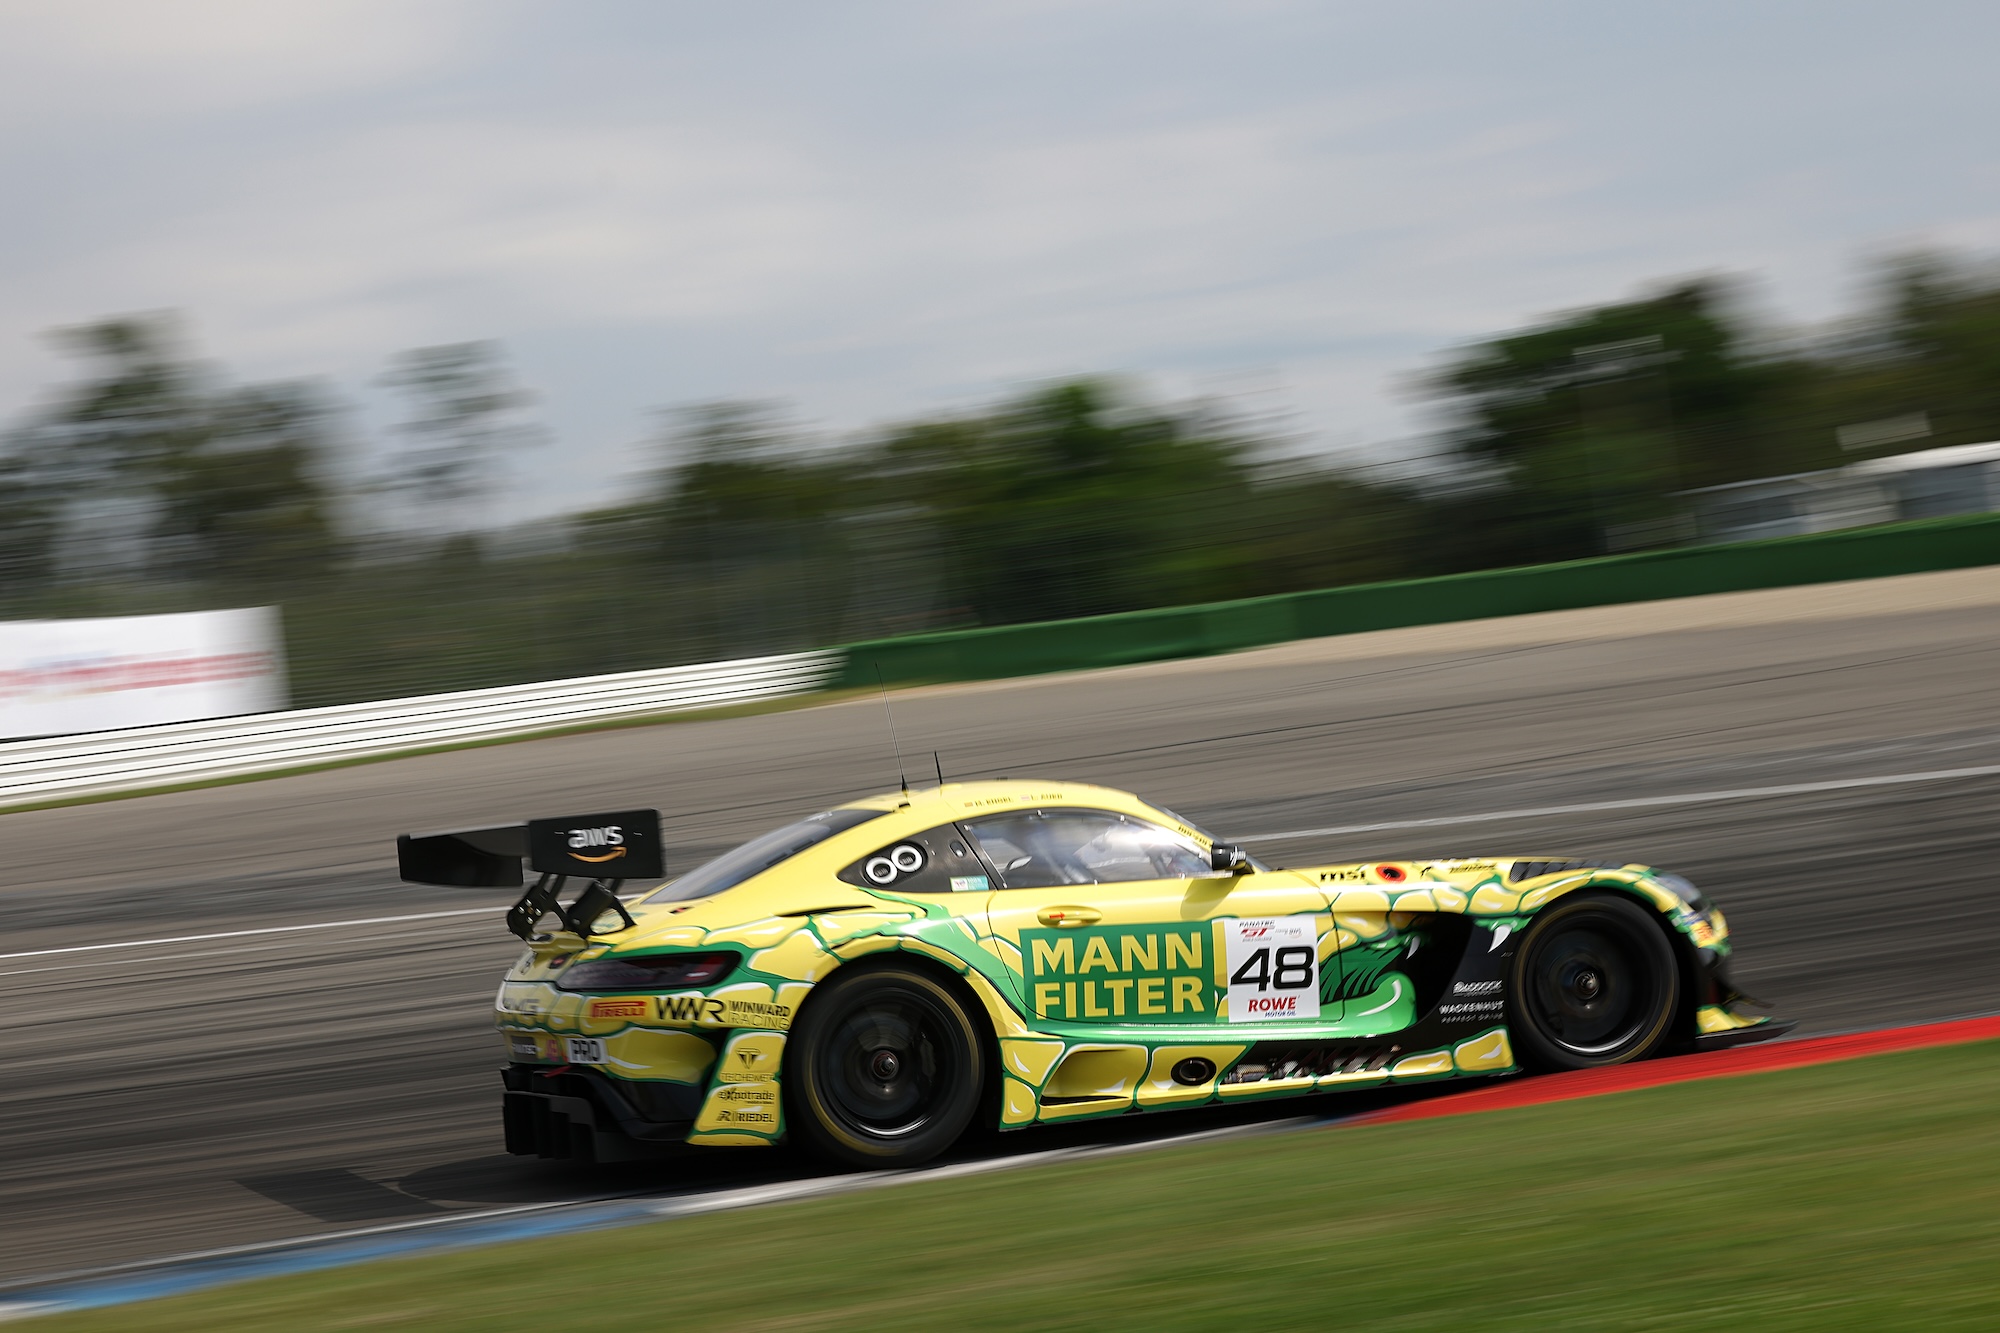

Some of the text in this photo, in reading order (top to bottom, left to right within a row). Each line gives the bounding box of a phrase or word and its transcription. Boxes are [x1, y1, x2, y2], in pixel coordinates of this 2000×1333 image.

[567, 825, 624, 848] aws
[1031, 932, 1203, 977] MANN
[1230, 946, 1314, 992] 48
[1034, 976, 1205, 1020] FILTER
[1248, 996, 1297, 1013] ROWE
[591, 1000, 647, 1018] PIRELLI
[729, 1000, 791, 1018] WINWARD
[730, 1011, 791, 1030] RACING
[569, 1038, 600, 1062] PRO
[739, 1112, 775, 1123] RIEDEL
